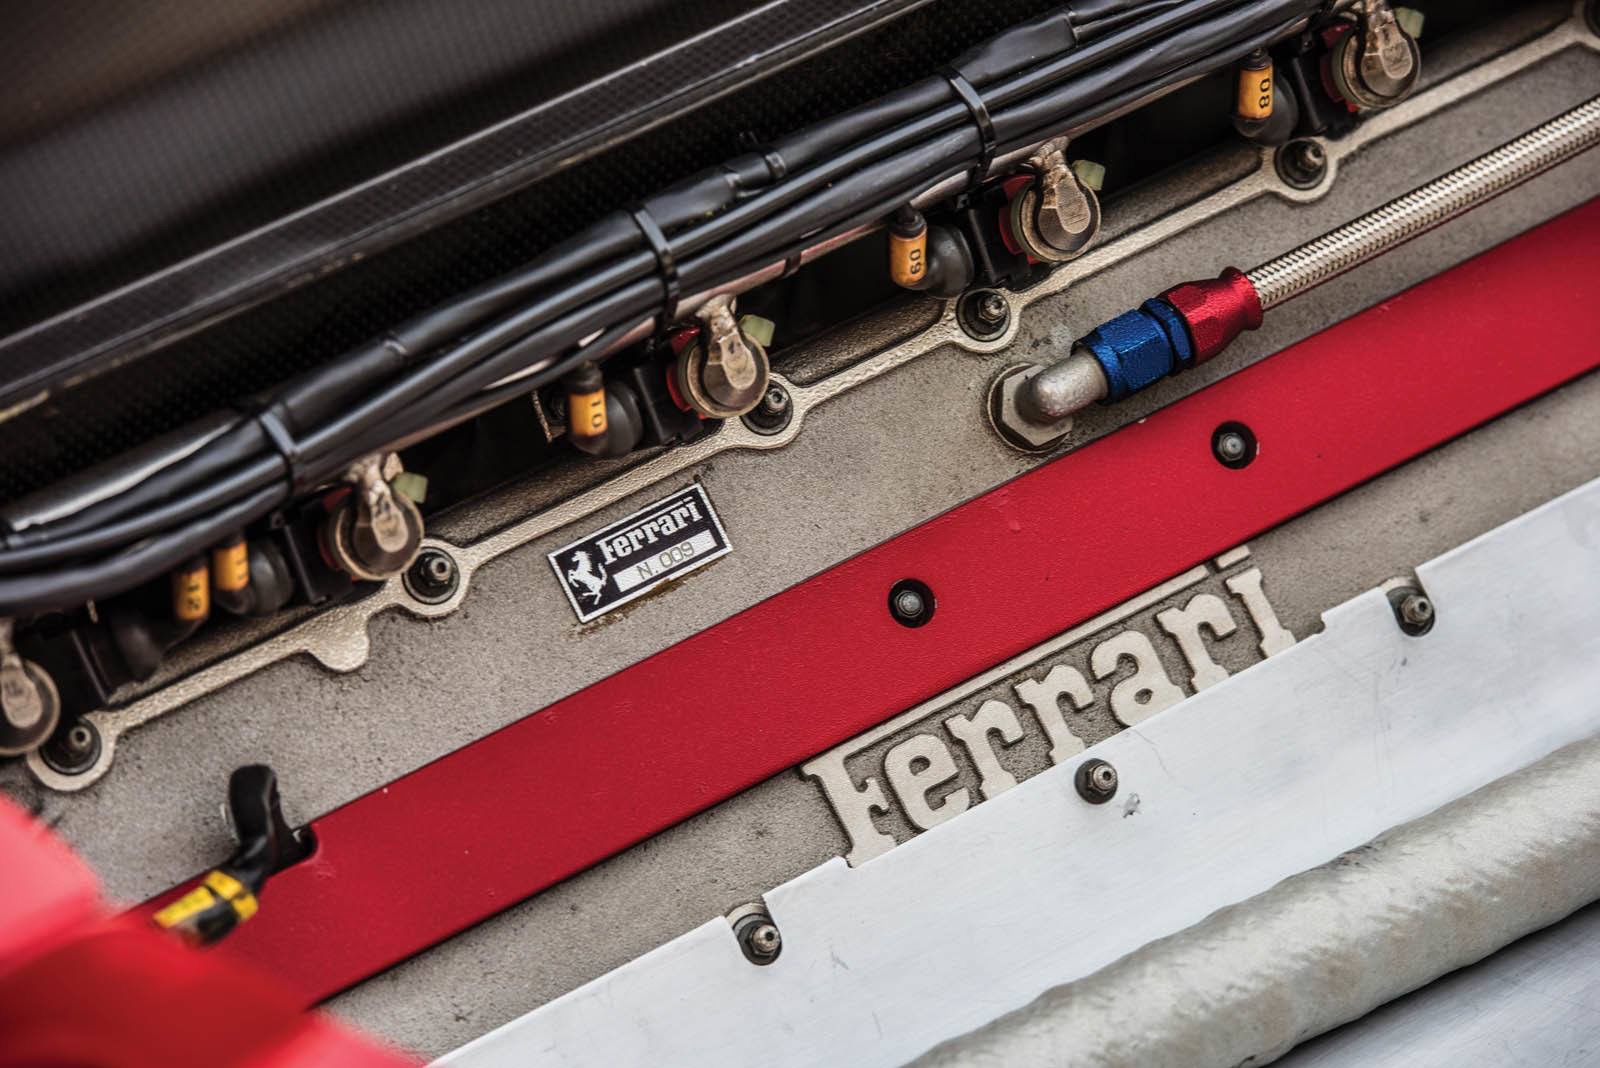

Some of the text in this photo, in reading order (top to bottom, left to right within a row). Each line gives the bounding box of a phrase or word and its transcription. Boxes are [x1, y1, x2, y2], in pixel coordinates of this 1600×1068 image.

[1258, 78, 1271, 109] 08
[595, 496, 703, 566] Ferrari
[800, 545, 1297, 868] Ferrari
